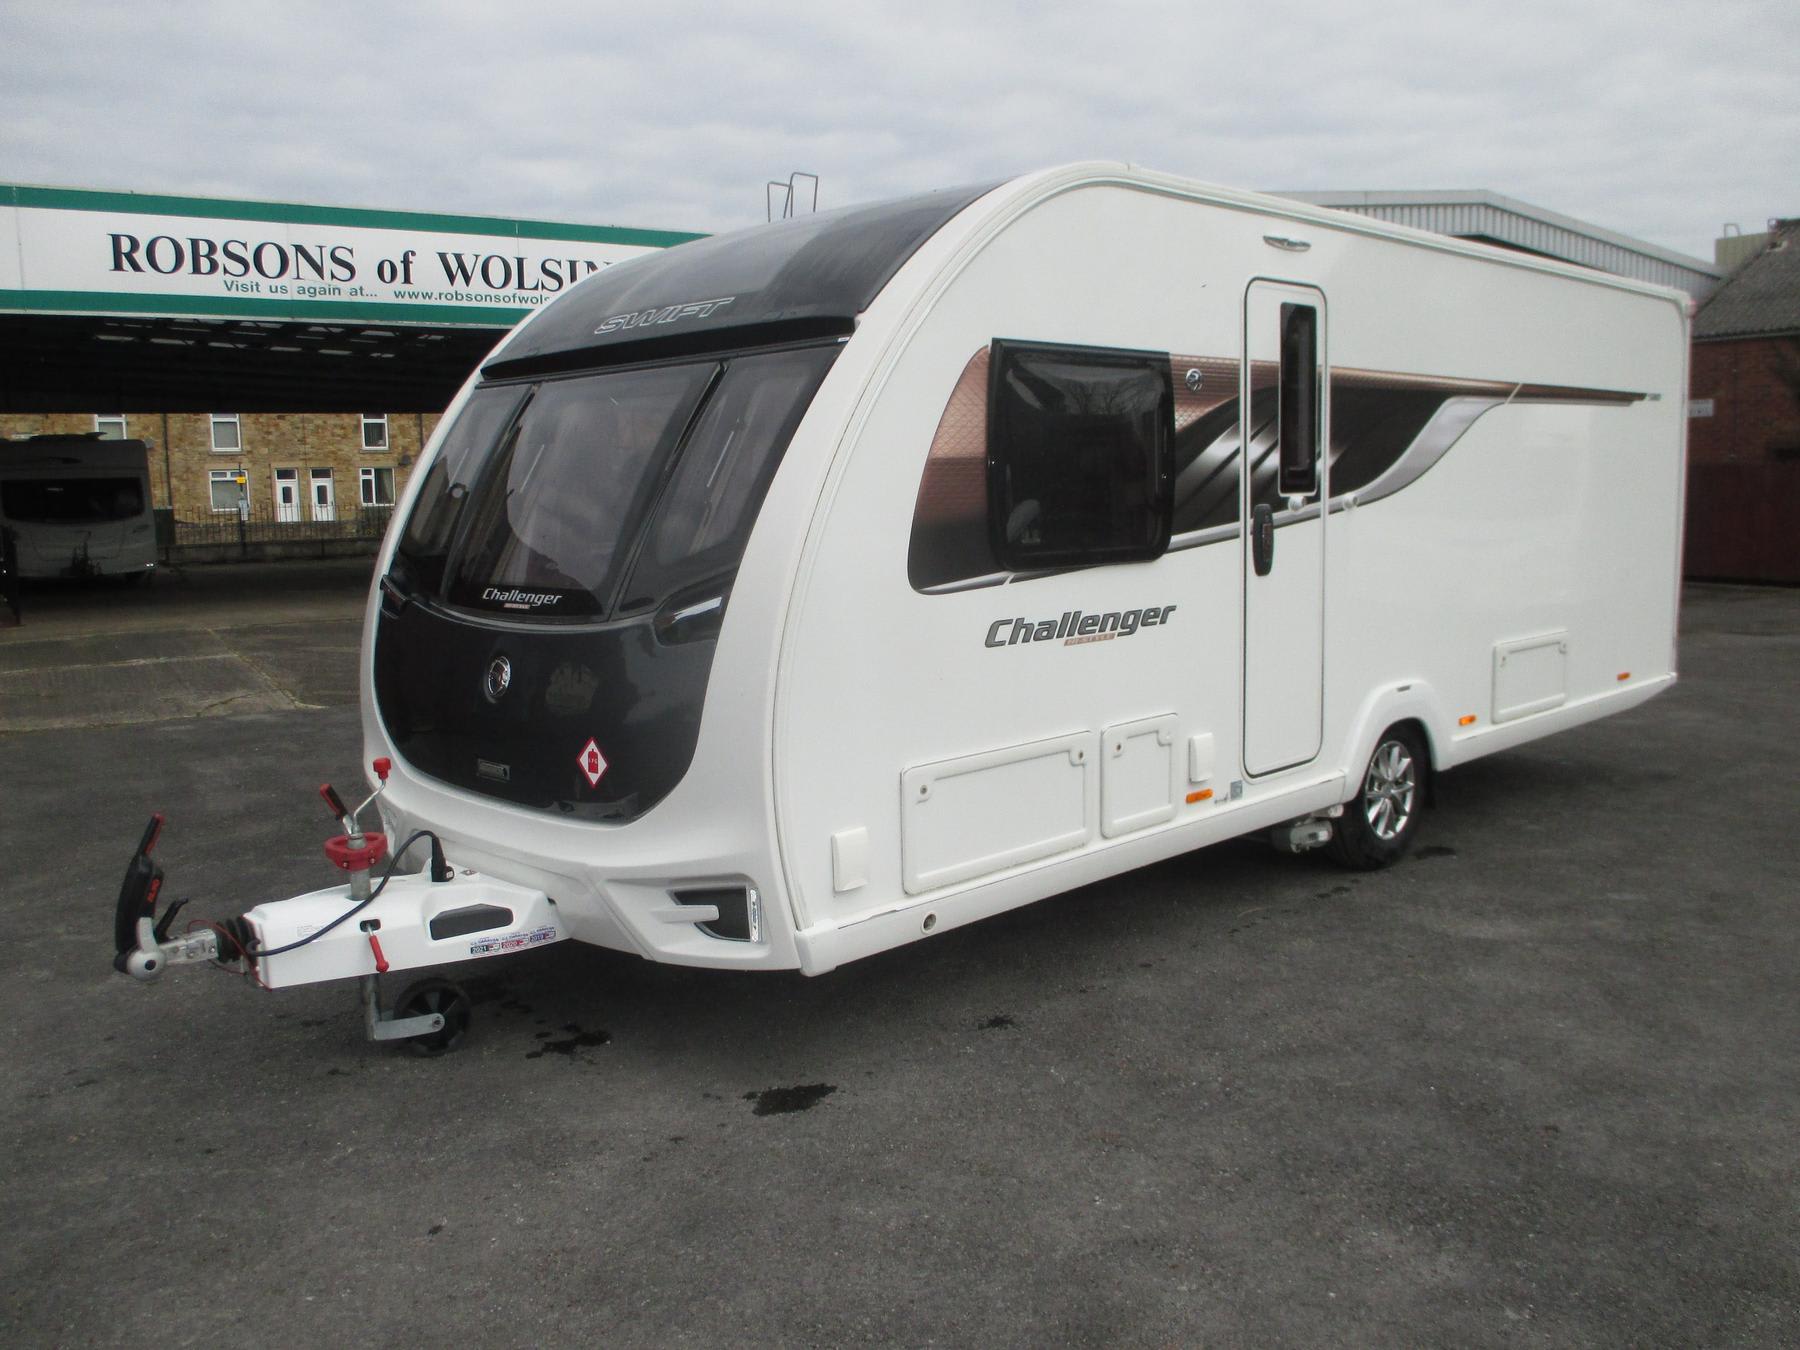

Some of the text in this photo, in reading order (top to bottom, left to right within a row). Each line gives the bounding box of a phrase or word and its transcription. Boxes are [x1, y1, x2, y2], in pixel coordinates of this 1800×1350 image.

[107, 233, 356, 282] ROBSONS
[377, 250, 416, 285] of
[223, 280, 261, 293] Visit
[269, 284, 288, 294] us
[297, 282, 341, 297] again
[349, 285, 378, 297] at...
[594, 296, 736, 334] SWIFT
[482, 588, 563, 606] Challenger
[984, 605, 1177, 648] Challenger
